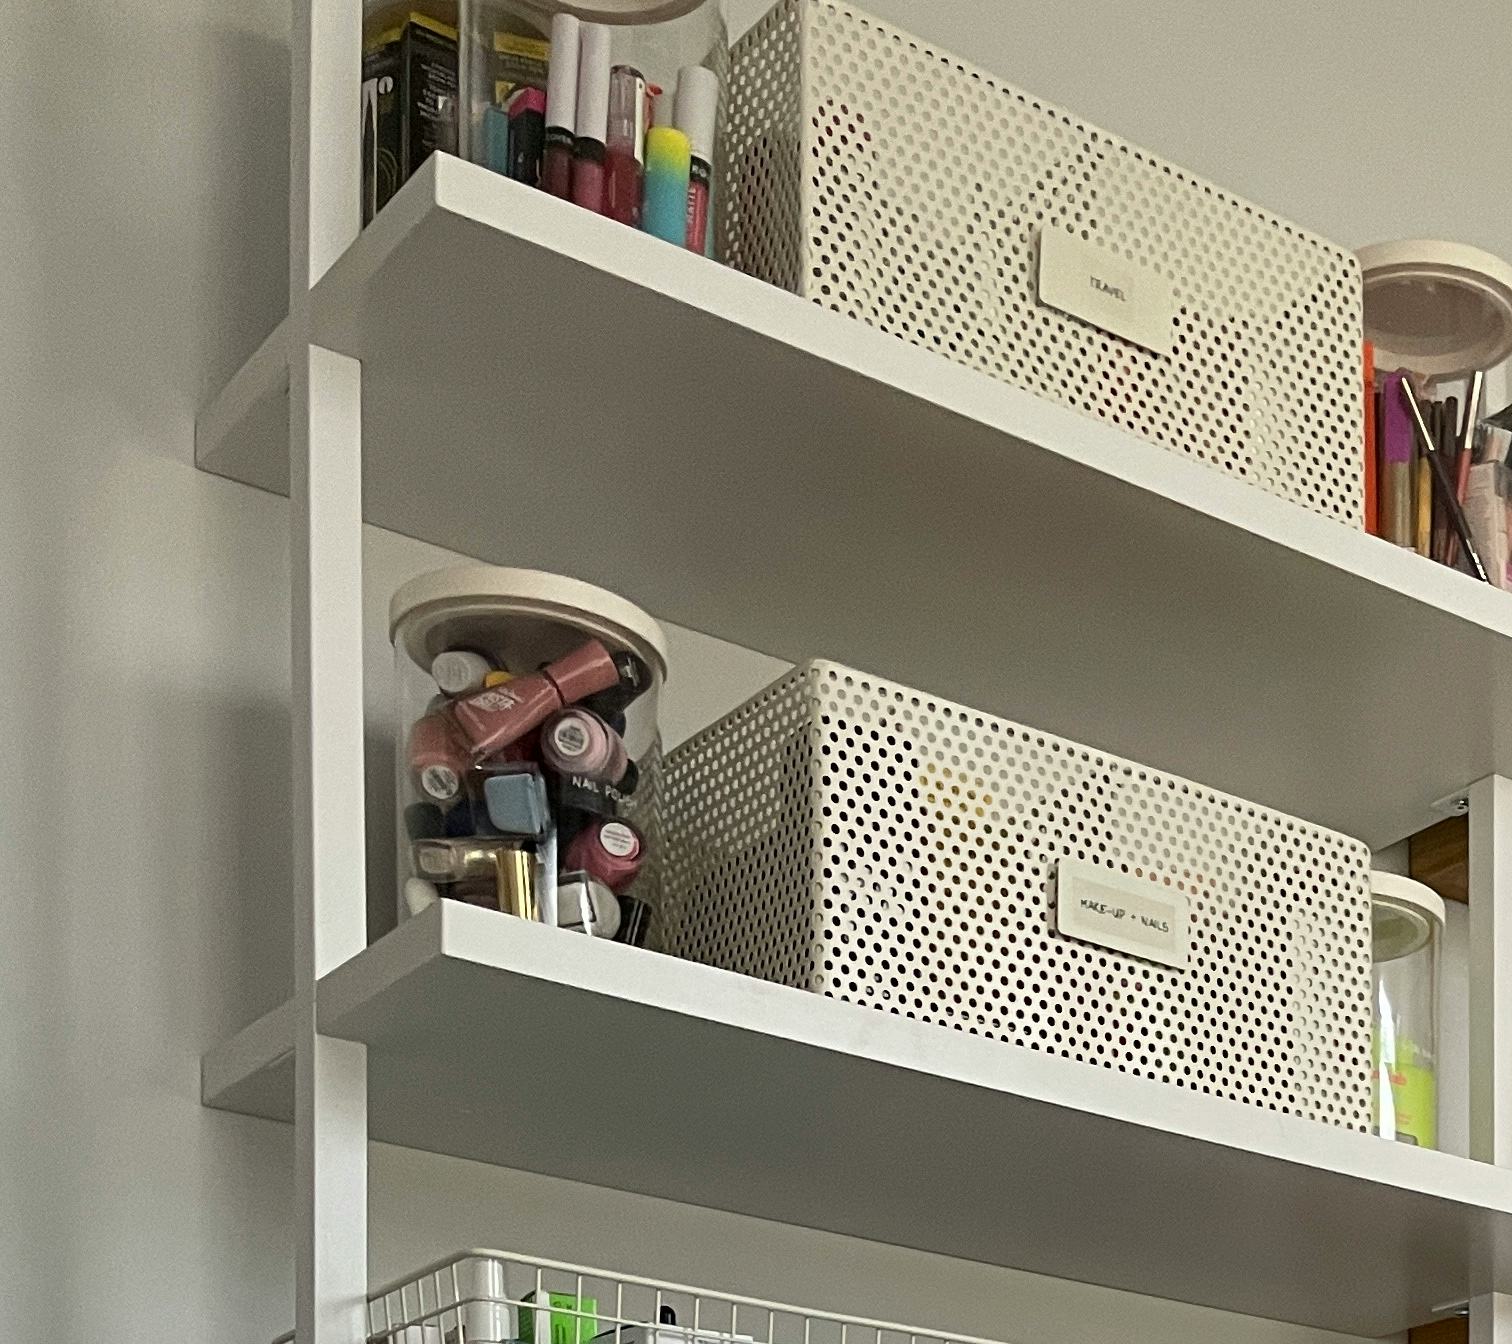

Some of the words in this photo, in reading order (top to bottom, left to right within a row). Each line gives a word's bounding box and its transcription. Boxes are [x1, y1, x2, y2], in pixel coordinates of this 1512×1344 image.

[572, 776, 600, 793] NAIL
[1080, 899, 1126, 919] MAKE-UP
[1140, 916, 1169, 933] NAILS
